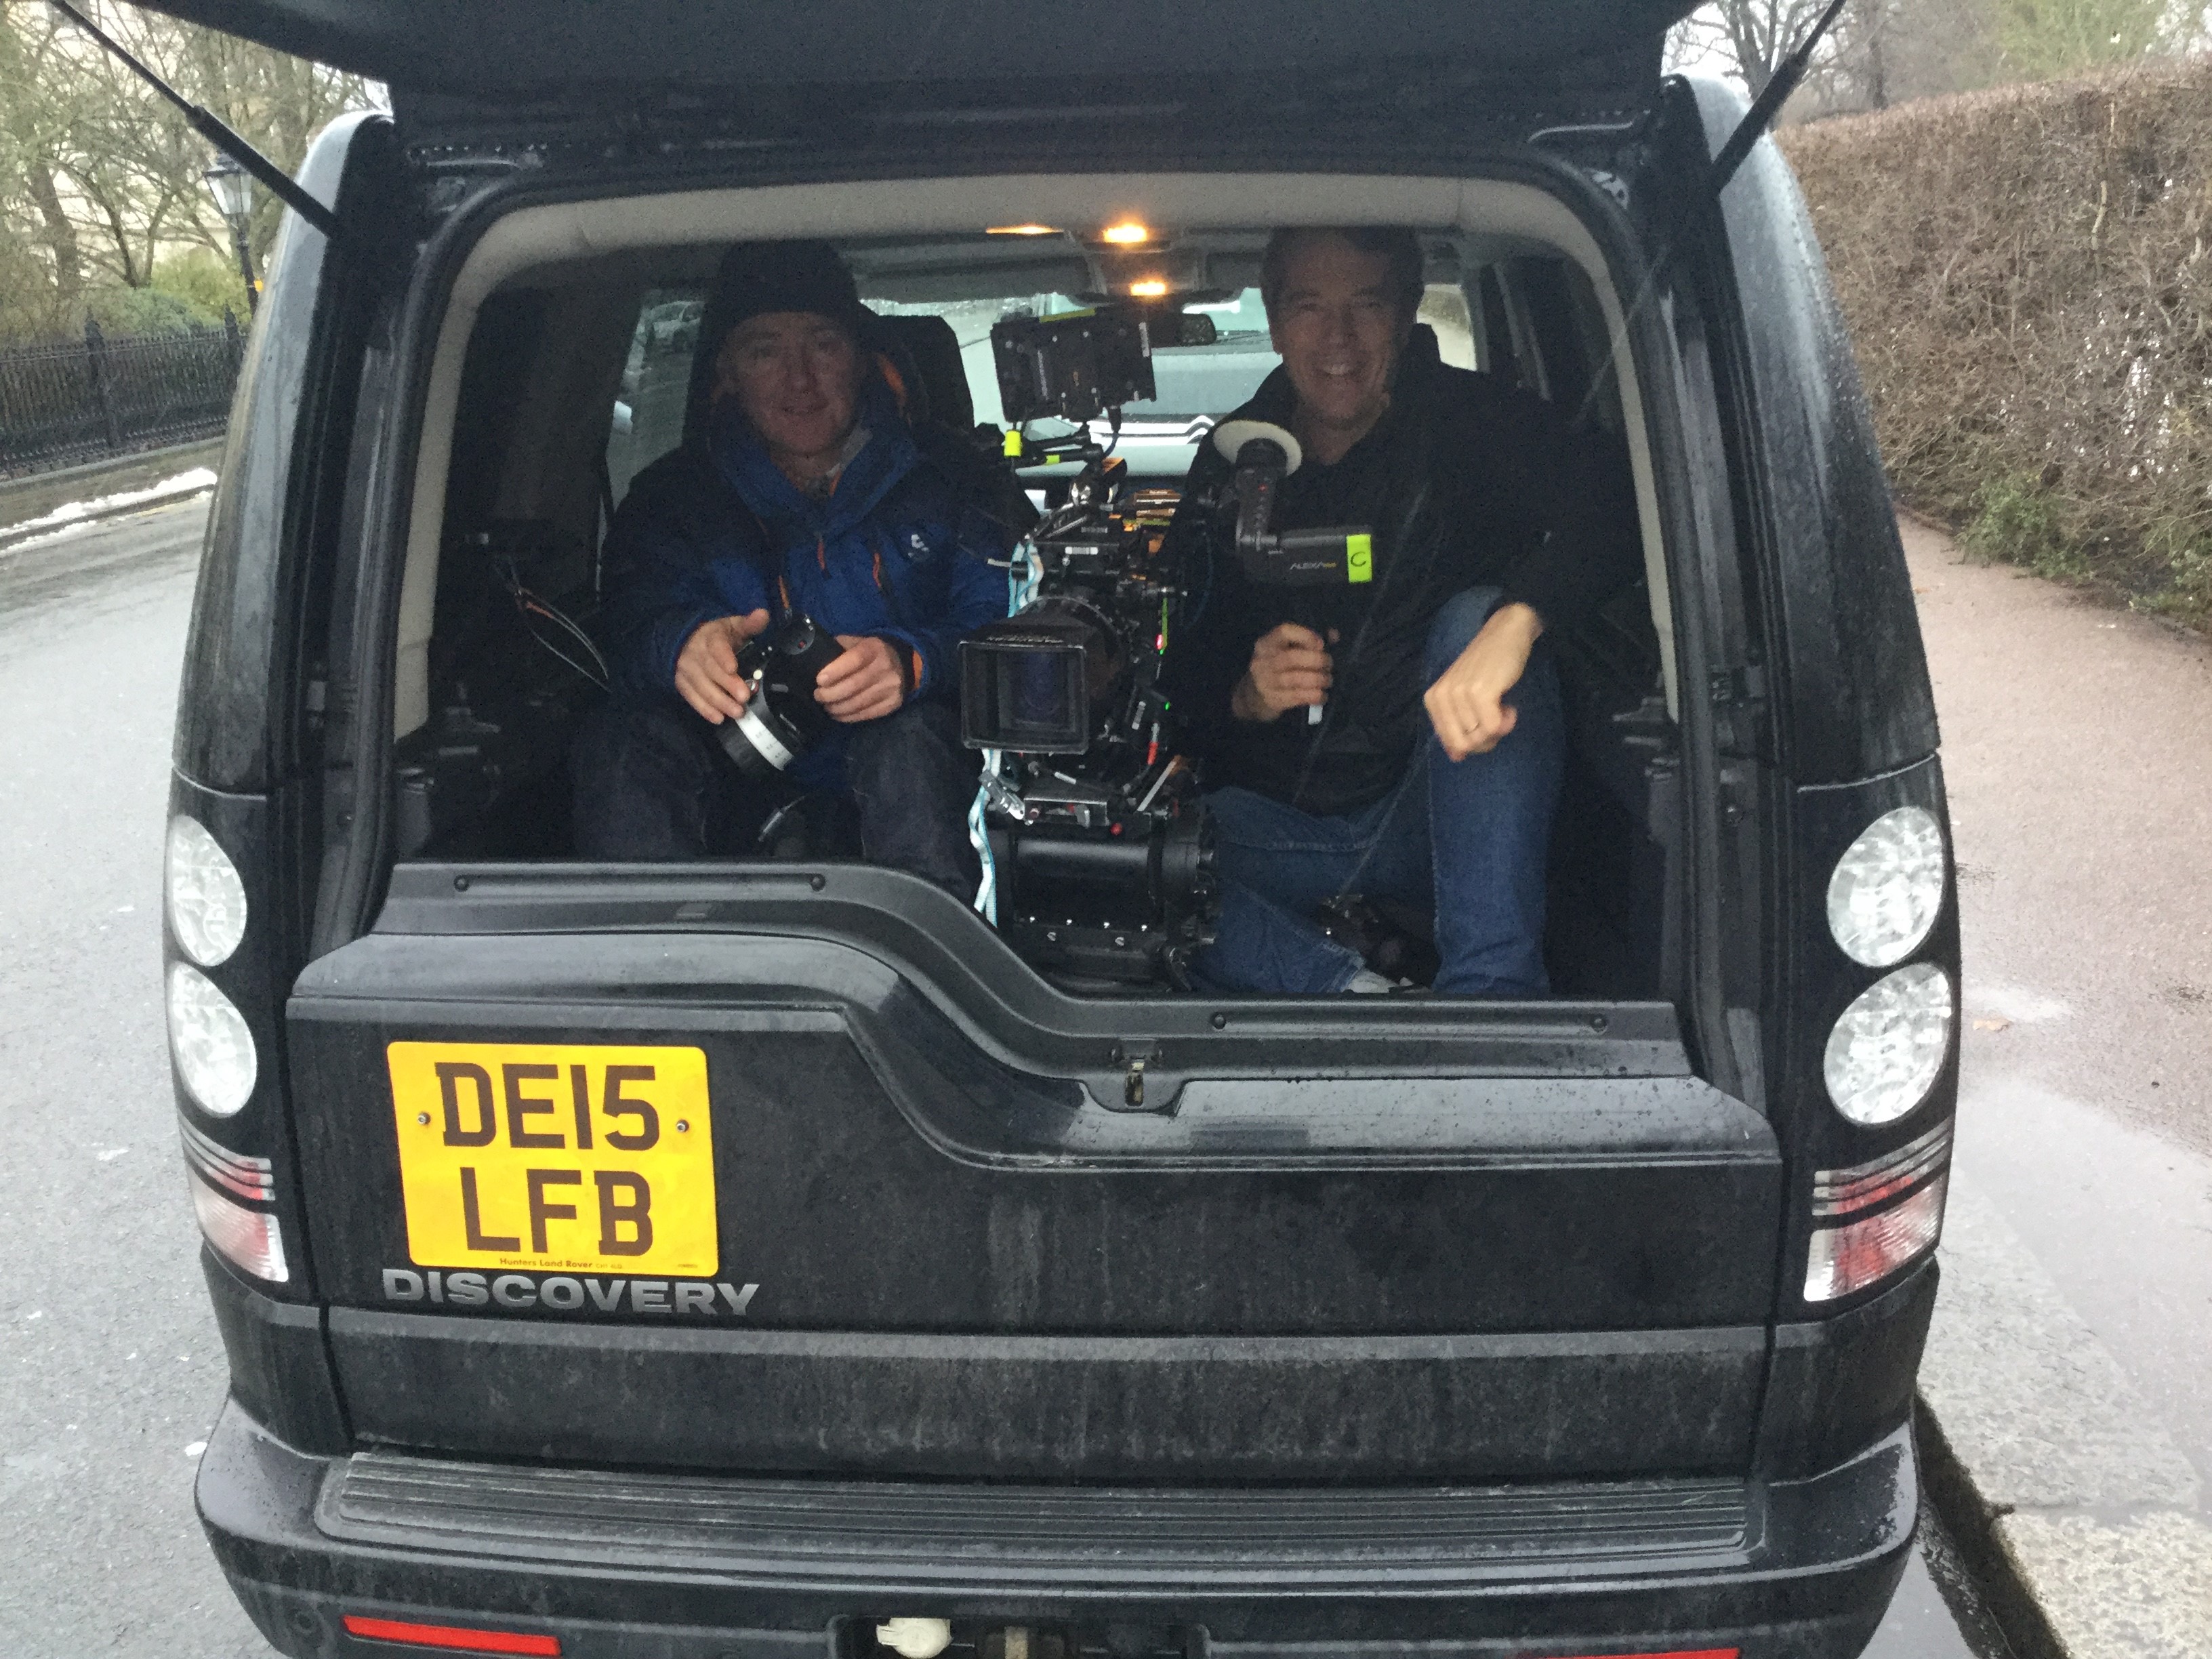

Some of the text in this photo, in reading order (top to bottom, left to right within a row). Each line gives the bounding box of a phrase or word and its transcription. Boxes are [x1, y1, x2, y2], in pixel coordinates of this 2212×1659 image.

[1350, 551, 1366, 567] C
[434, 1062, 660, 1151] DE15
[459, 1166, 654, 1257] LFB
[499, 1258, 536, 1266] Hunters
[539, 1259, 562, 1267] Land
[565, 1260, 592, 1268] Rover
[382, 1268, 760, 1316] DISCOVERY
